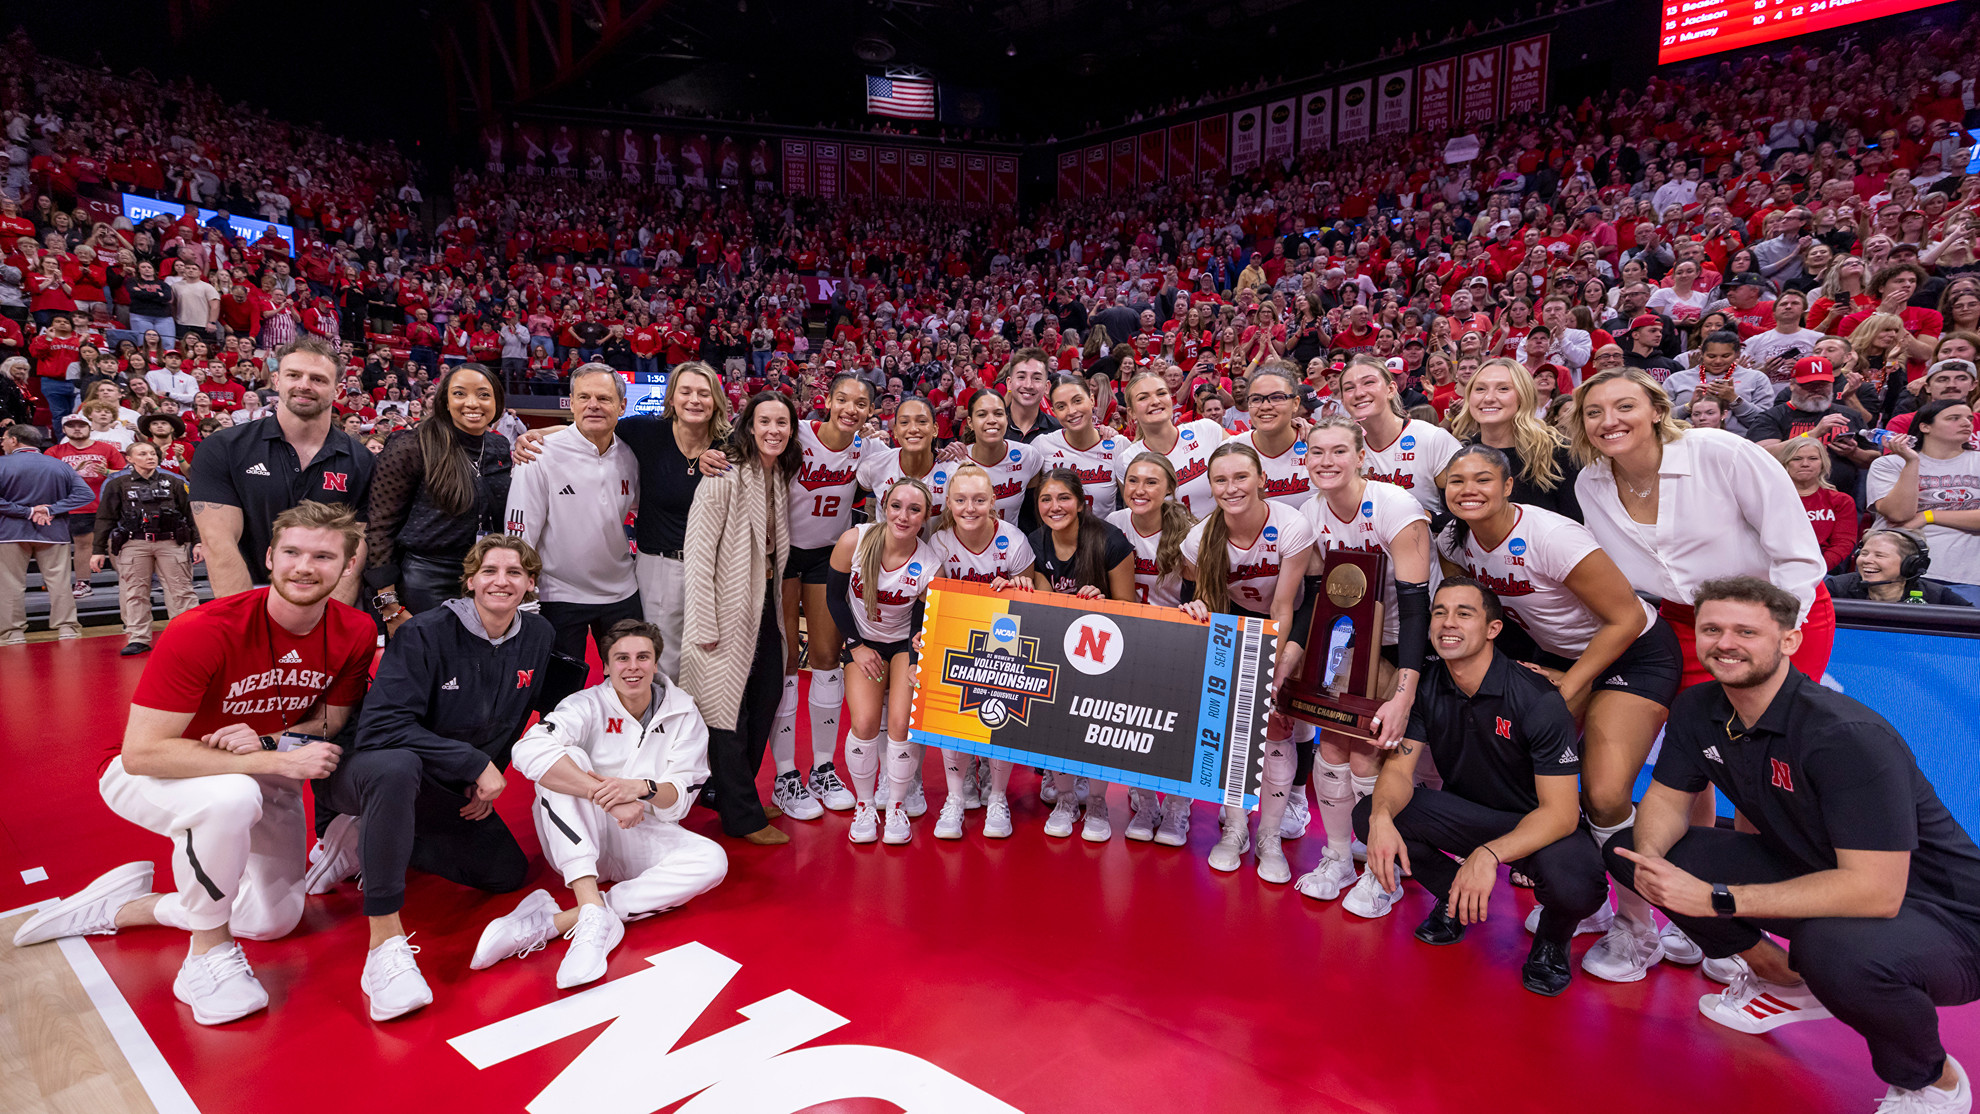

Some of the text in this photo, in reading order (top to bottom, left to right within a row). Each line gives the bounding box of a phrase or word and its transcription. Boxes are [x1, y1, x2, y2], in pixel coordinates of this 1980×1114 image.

[1666, 6, 1678, 16] 13
[1810, 2, 1826, 12] 24
[1662, 6, 1804, 46] 27 Murray 10 4 12
[1665, 20, 1676, 30] 15
[1681, 10, 1728, 26] Jackson
[1513, 41, 1542, 72] N
[1467, 53, 1495, 82] N
[1511, 70, 1539, 83] NCAA
[1424, 64, 1449, 92] N
[1465, 81, 1492, 93] NCAA
[1422, 91, 1448, 102] NCAA
[1186, 347, 1198, 358] 15
[1811, 361, 1823, 373] N
[647, 374, 665, 383] 1:30
[322, 471, 348, 492] N
[621, 480, 629, 495] N
[811, 495, 841, 517] 12
[994, 627, 1016, 638] NCAA
[1073, 625, 1112, 664] N
[974, 657, 1025, 675] VOLLEYBALL
[516, 669, 535, 689] N
[949, 664, 1048, 693] CHAMPIONSHIP
[973, 687, 1020, 701] 2024 LOUISVILLE
[1069, 695, 1178, 732] LOUISVILLE
[1200, 623, 1233, 787] SECTION 12 ROW 19 SEAT 24
[1317, 706, 1353, 723] CHAMPION
[606, 717, 624, 734] N
[1495, 716, 1511, 740] N
[1084, 723, 1155, 754] BOUND
[1770, 757, 1794, 792] N
